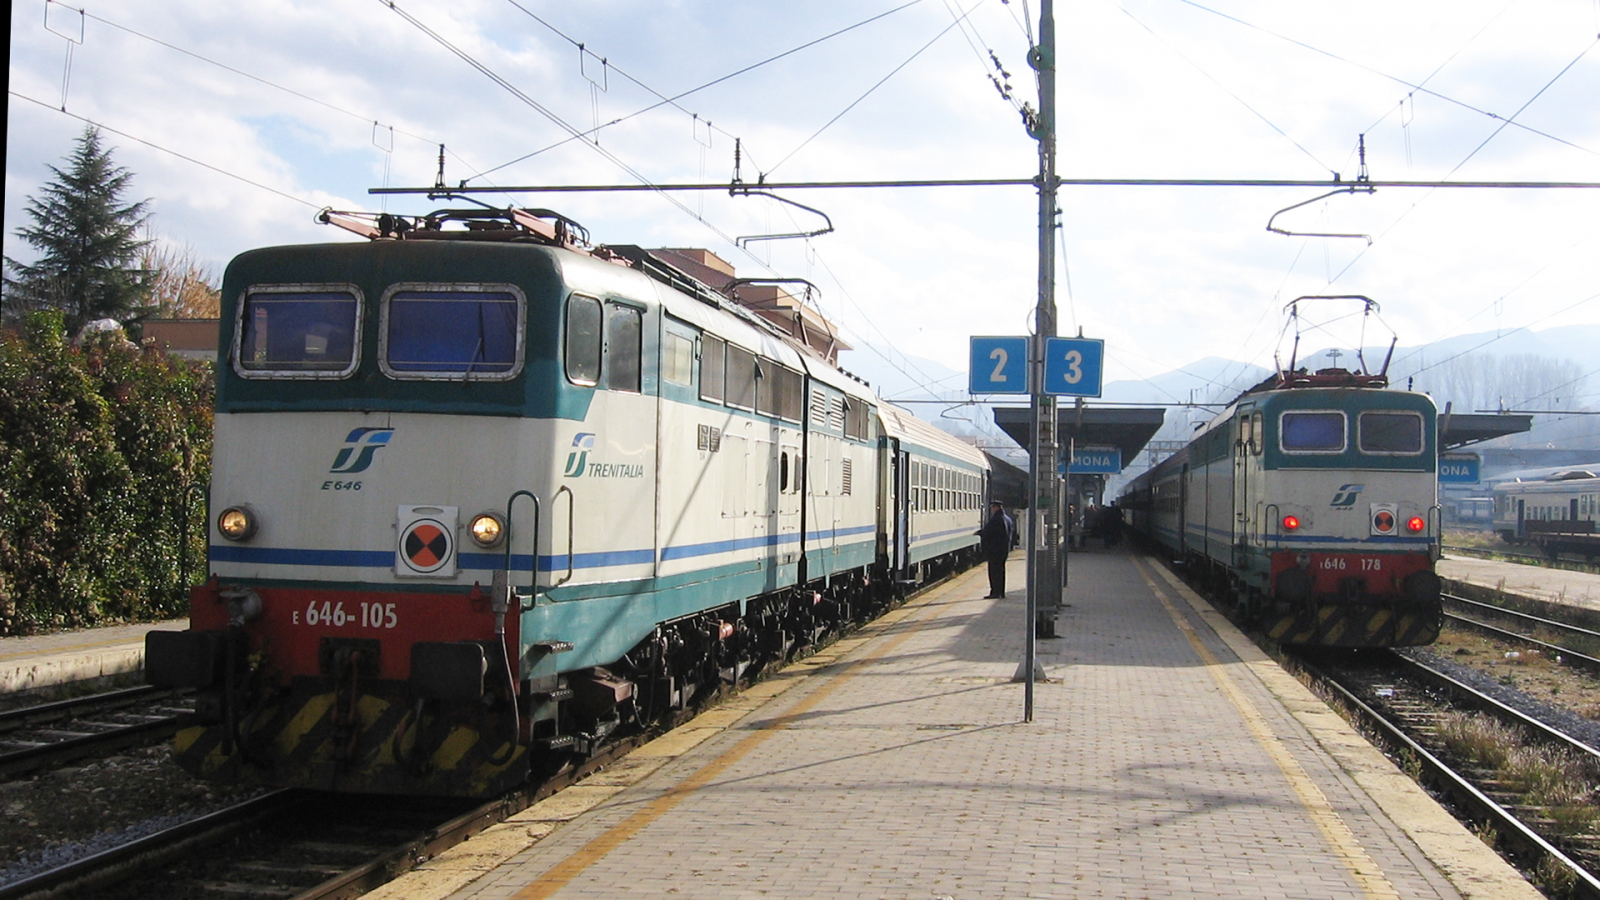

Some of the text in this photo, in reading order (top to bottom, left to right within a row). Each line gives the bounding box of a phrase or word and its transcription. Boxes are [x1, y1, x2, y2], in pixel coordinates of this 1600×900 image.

[989, 348, 1008, 382] 2
[1063, 350, 1083, 384] 3
[1057, 456, 1111, 466] MONA
[588, 463, 644, 478] TRENITALIA
[1440, 465, 1470, 476] ONA
[1324, 558, 1346, 570] 646
[1361, 558, 1381, 571] 178
[292, 611, 299, 625] E
